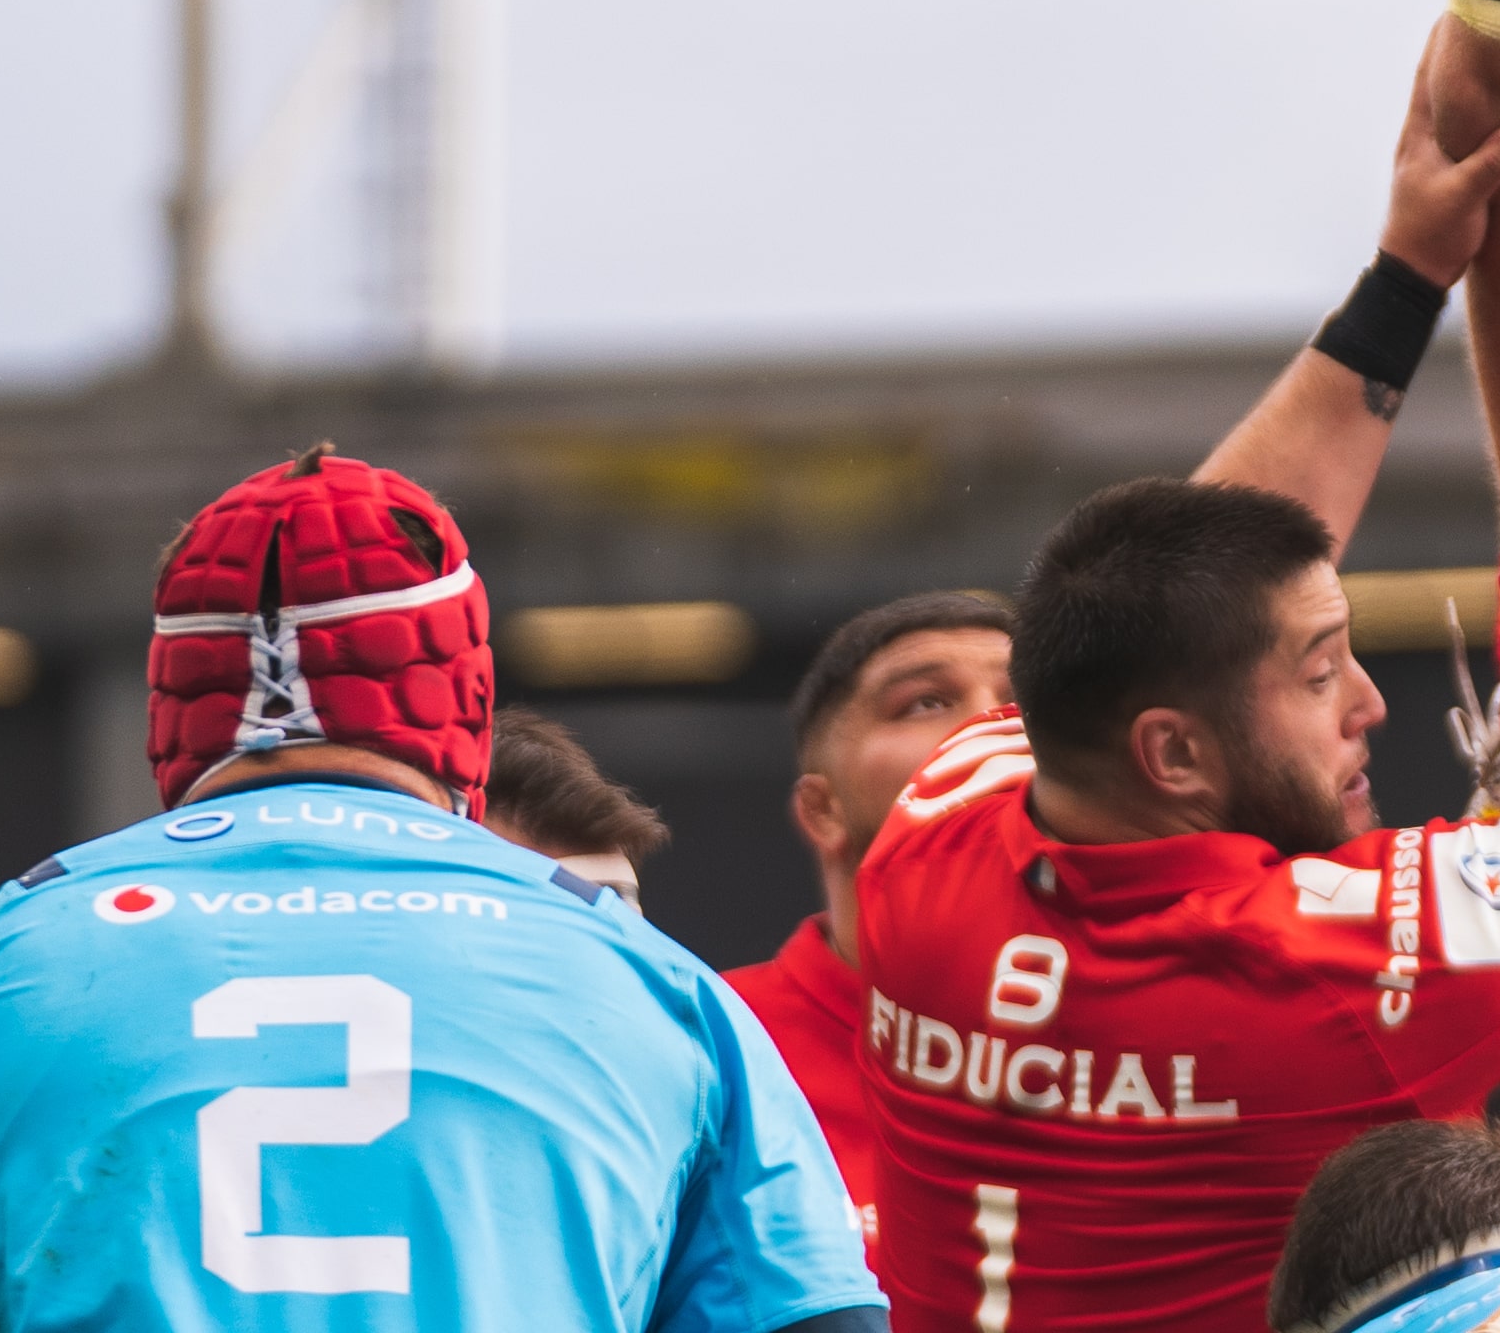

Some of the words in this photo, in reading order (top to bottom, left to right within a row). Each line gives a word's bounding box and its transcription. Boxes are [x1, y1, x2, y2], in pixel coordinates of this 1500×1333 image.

[188, 886, 509, 920] vodacom
[1375, 825, 1426, 1026] chausso
[871, 985, 1240, 1119] FIDUCIAL
[192, 973, 413, 1294] 2
[975, 1183, 1020, 1333] 1
